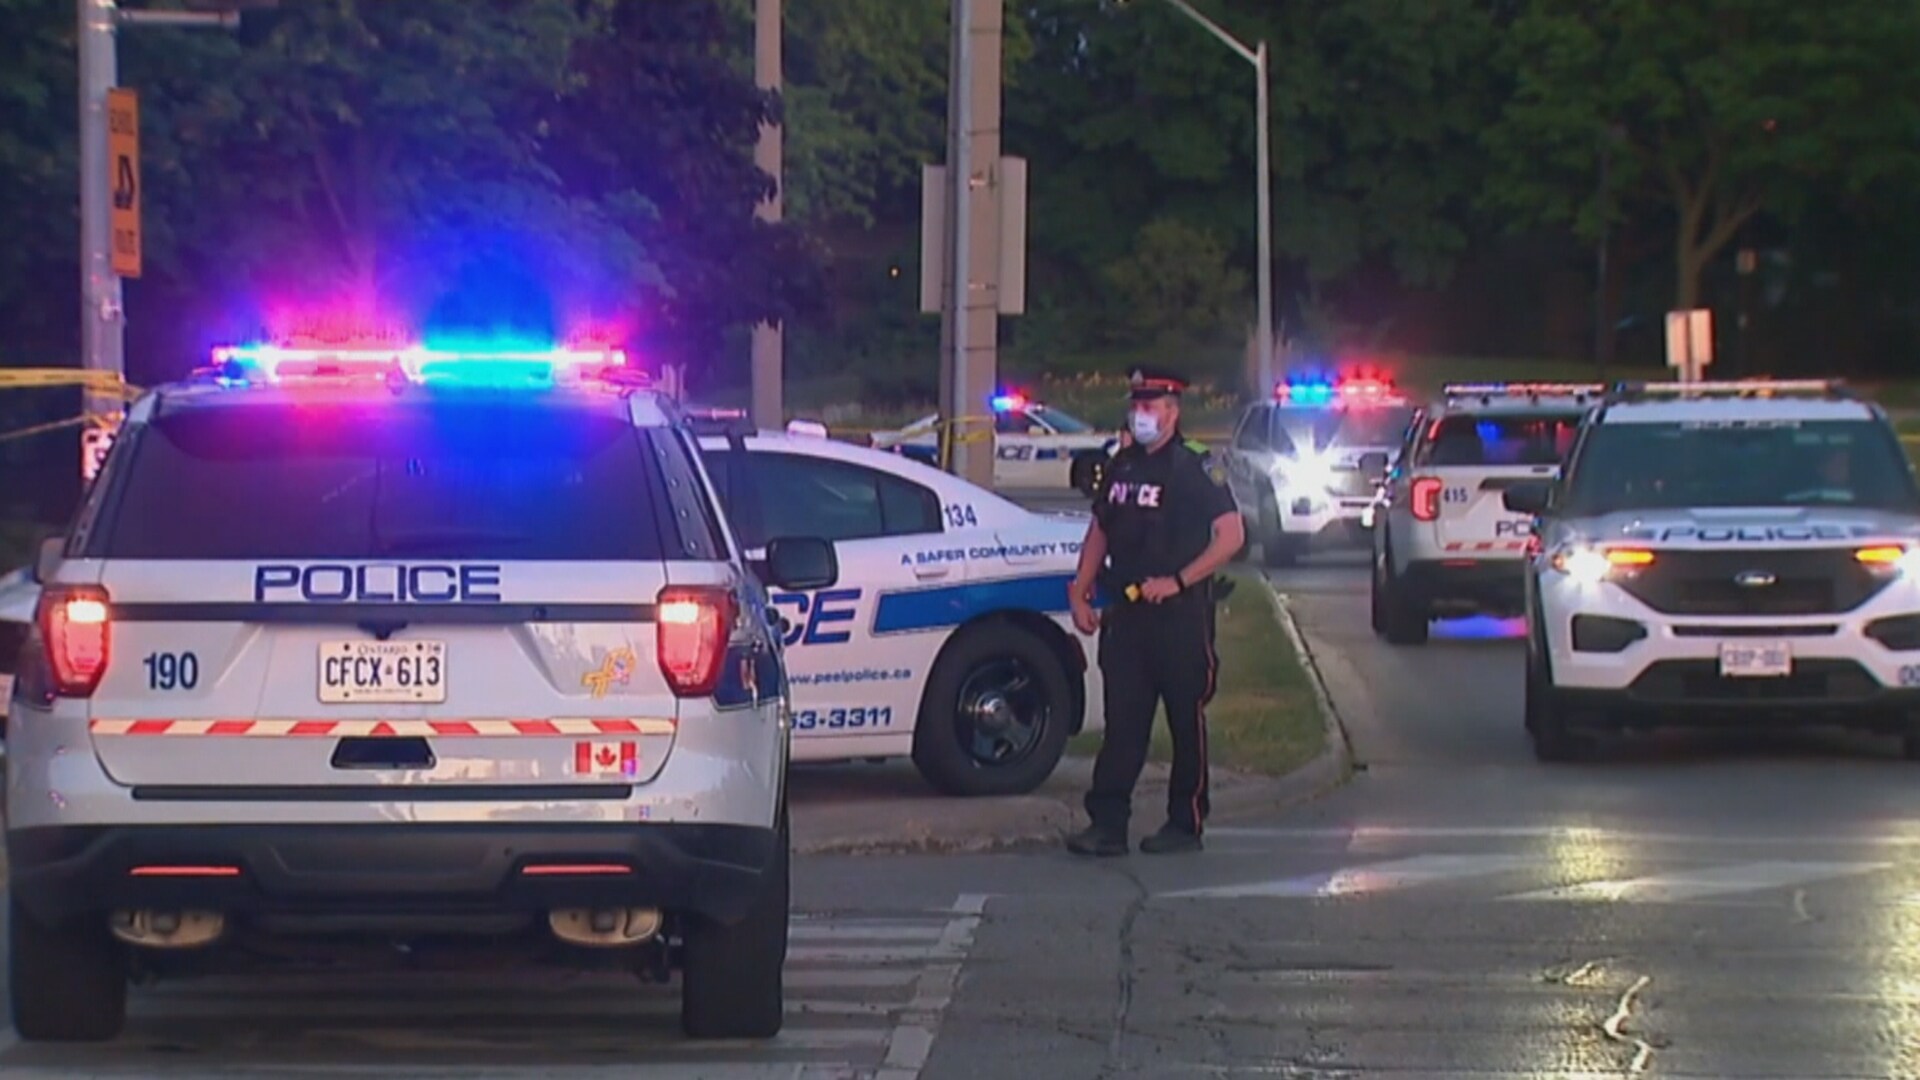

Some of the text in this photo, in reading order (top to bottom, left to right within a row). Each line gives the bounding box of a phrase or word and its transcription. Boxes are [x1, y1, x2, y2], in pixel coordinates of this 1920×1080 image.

[1108, 481, 1162, 507] POCE
[945, 504, 977, 527] 134
[901, 541, 1086, 565] A SAFER COMMUNITY TO
[255, 564, 501, 602] POLICE
[142, 651, 199, 690] 190
